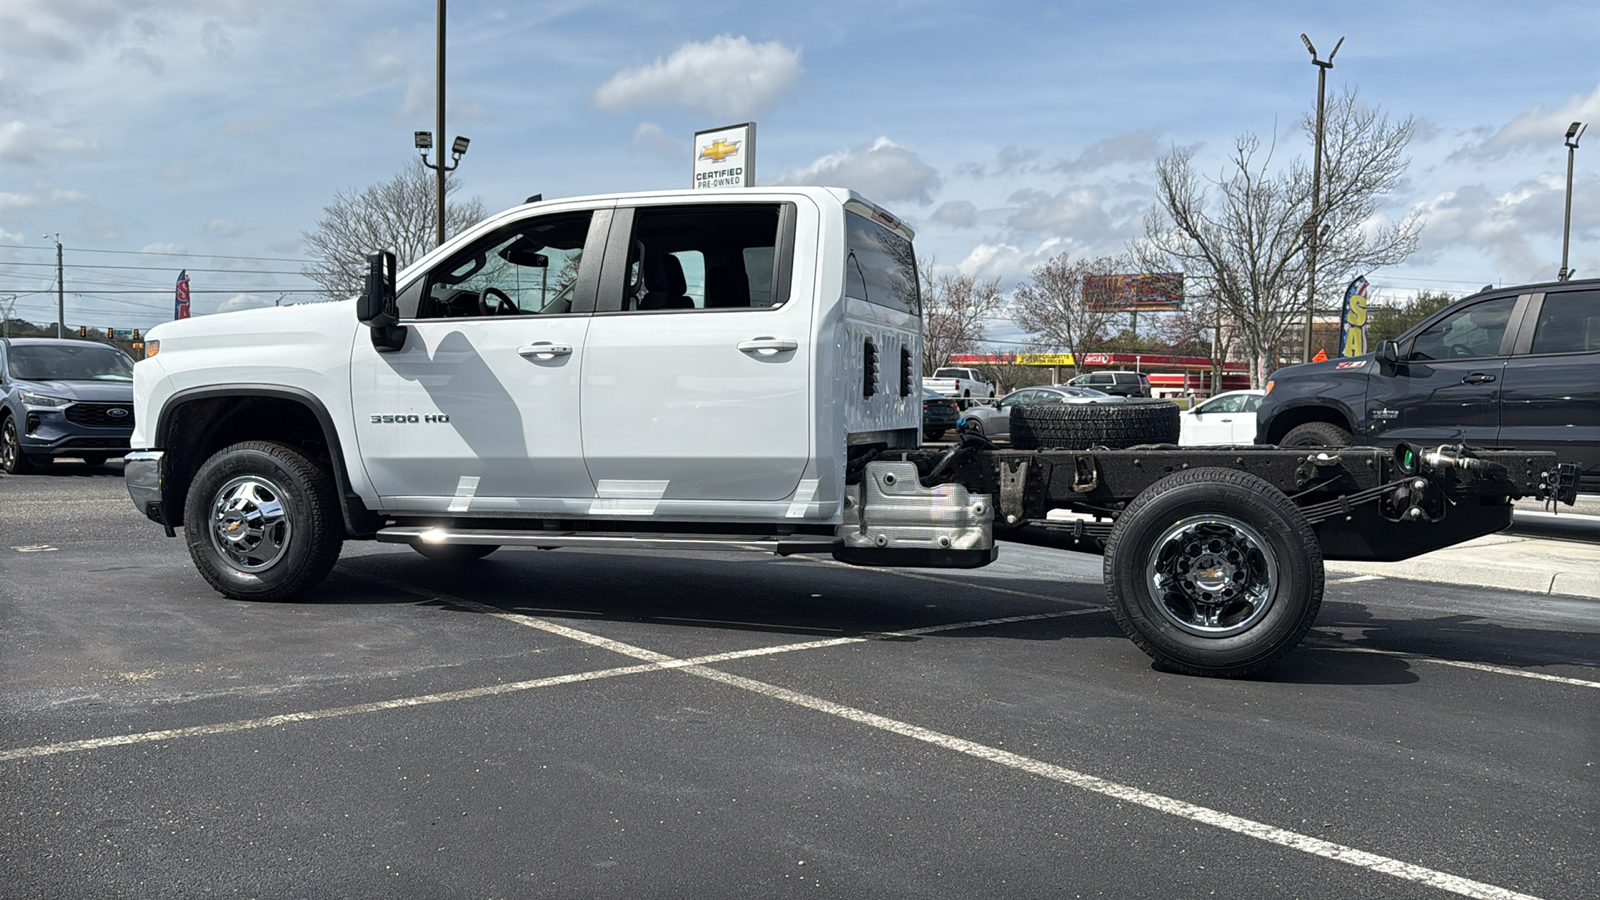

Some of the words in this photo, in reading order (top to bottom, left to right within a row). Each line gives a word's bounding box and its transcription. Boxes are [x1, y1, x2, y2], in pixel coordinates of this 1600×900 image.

[696, 167, 743, 181] CERTIFIED
[697, 176, 740, 189] PRE-OWNED
[370, 414, 420, 424] 3500
[424, 414, 450, 424] HD
